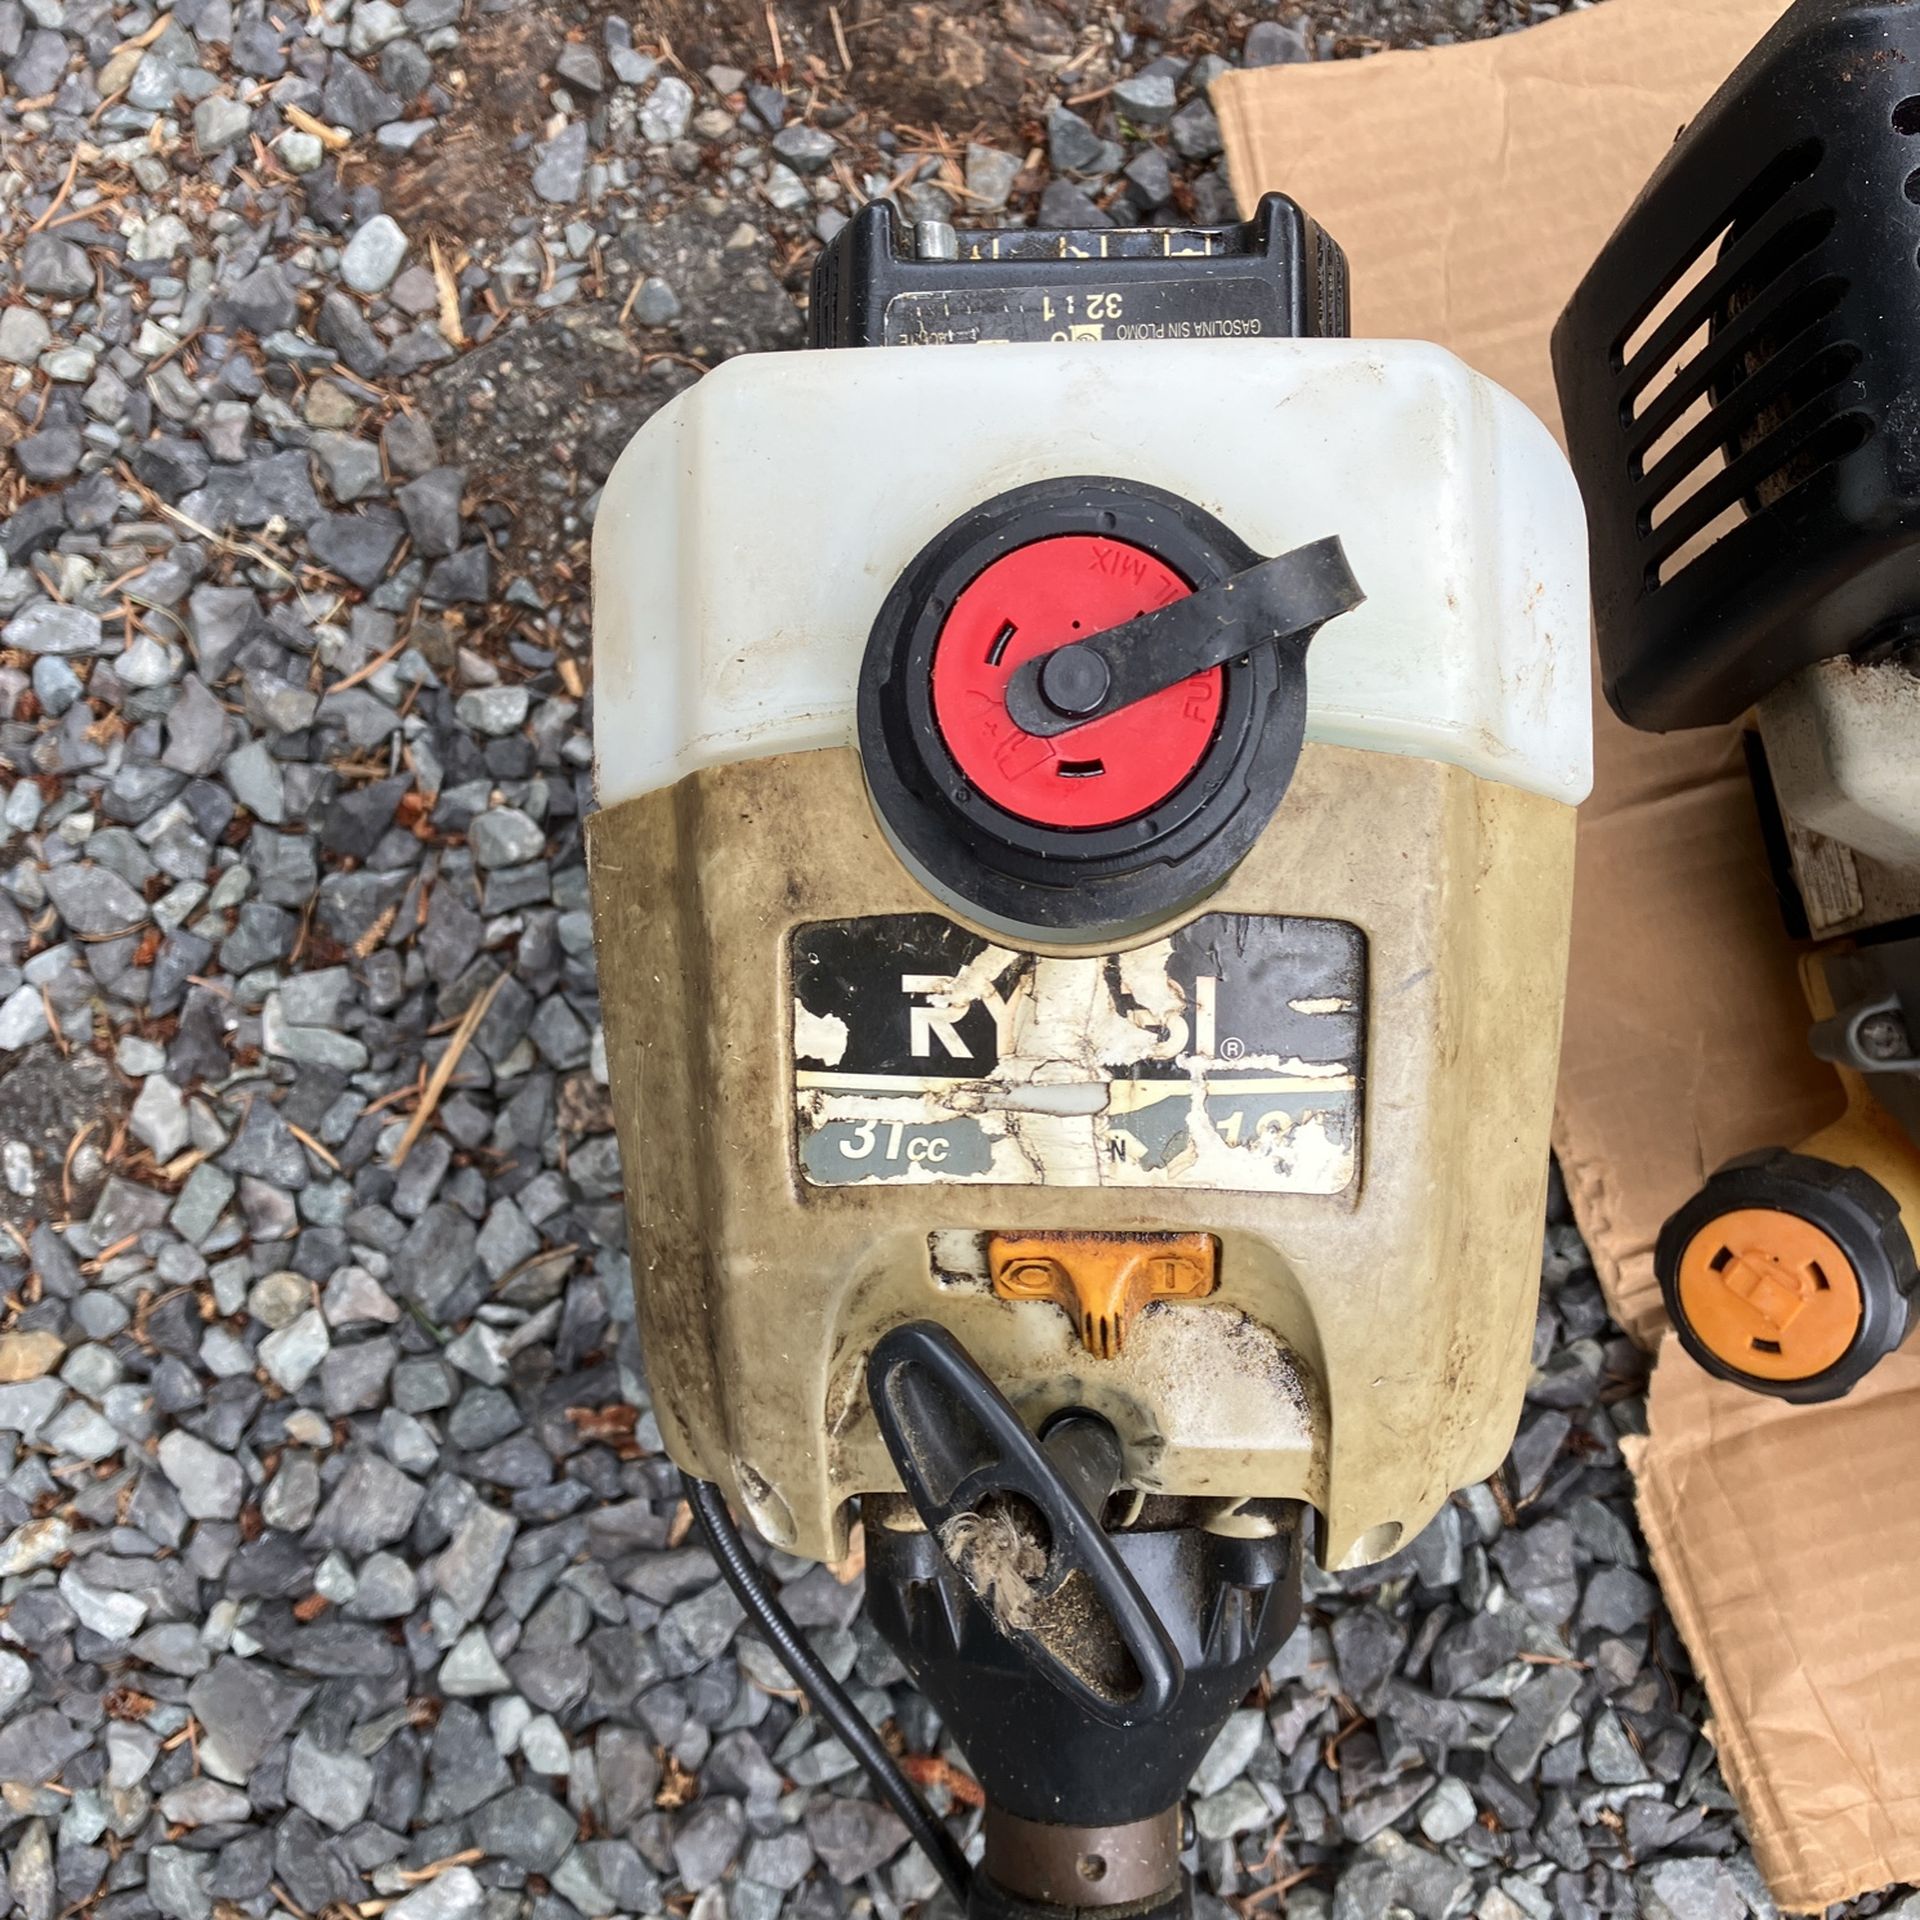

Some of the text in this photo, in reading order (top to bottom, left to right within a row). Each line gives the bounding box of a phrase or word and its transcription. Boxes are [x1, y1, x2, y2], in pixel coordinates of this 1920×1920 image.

[1043, 296, 1056, 322] 1
[1086, 293, 1123, 320] 32
[1116, 318, 1261, 340] GASOLINA SIN PLOMO
[1088, 546, 1147, 586] MIX
